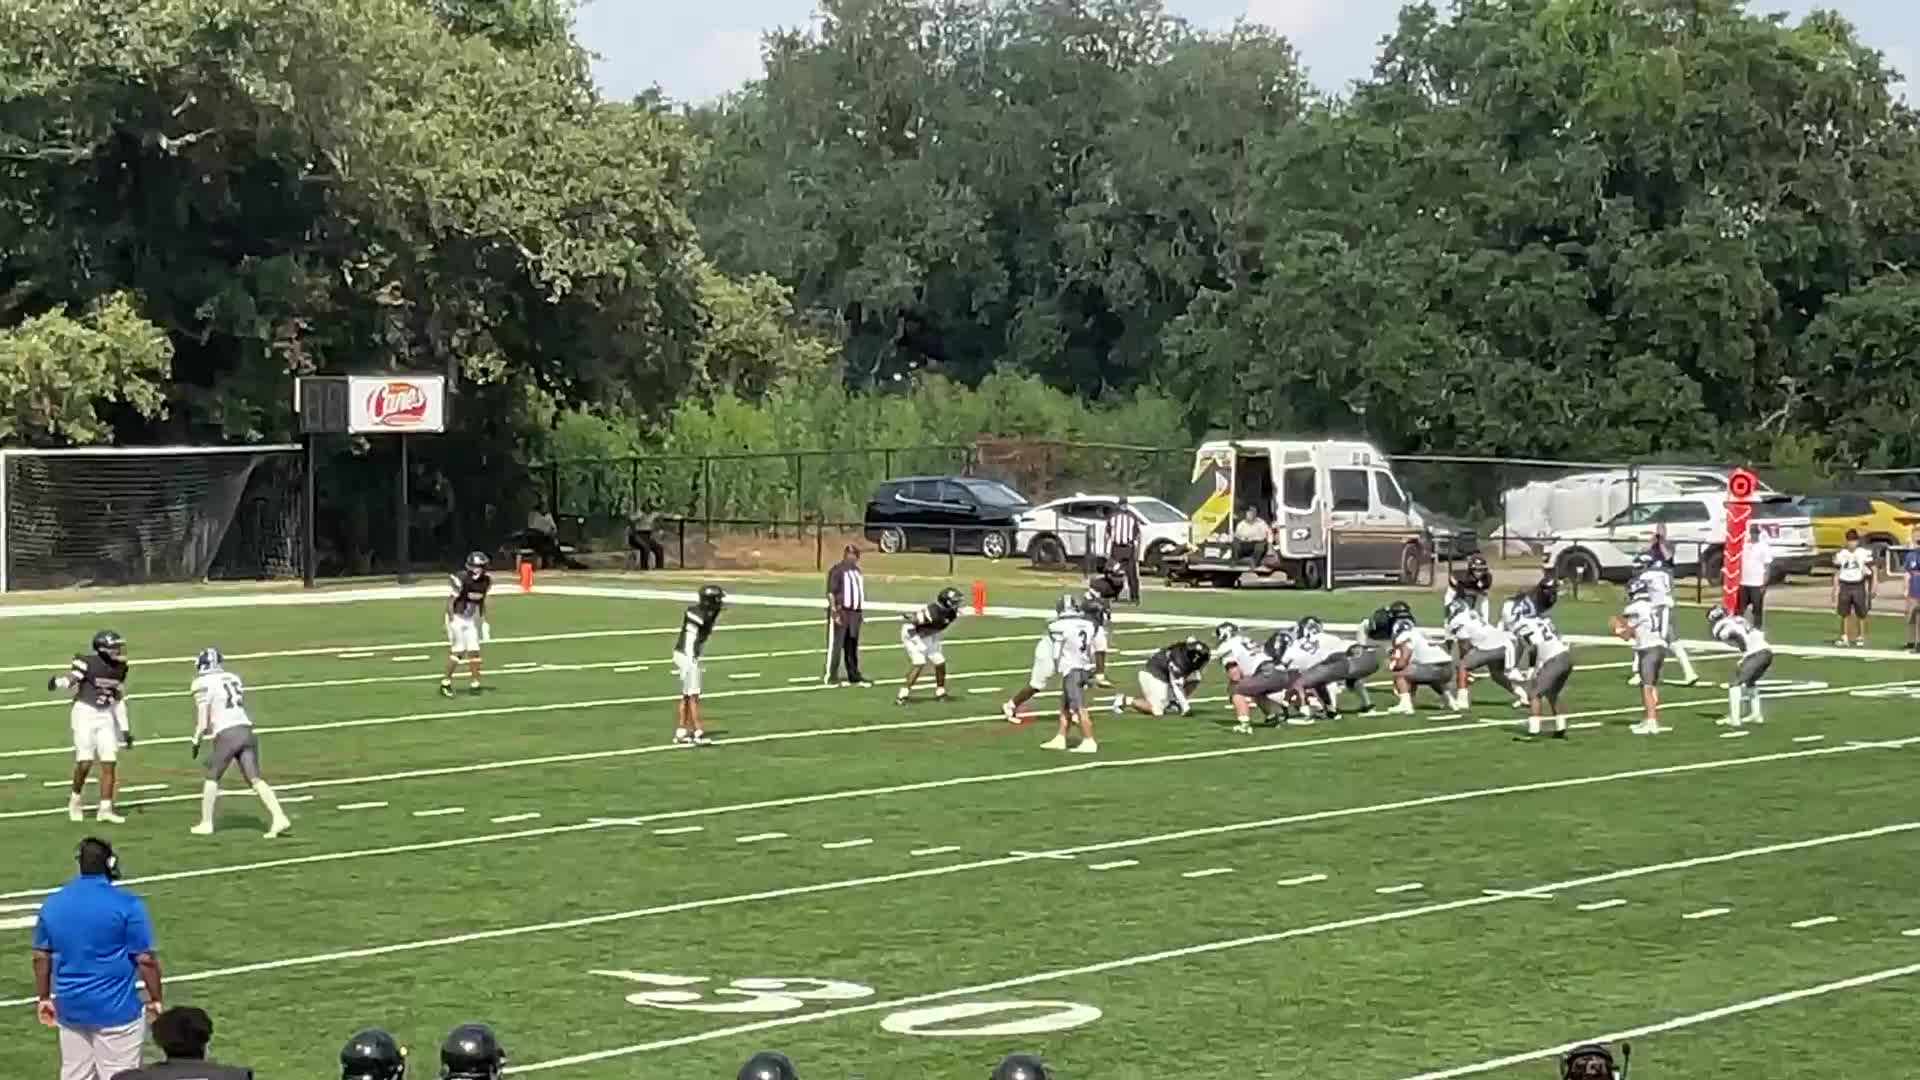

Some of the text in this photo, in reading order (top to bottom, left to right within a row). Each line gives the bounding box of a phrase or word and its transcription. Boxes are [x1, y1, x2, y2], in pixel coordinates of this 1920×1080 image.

[1078, 630, 1088, 652] 3
[223, 681, 243, 709] 15
[625, 977, 1099, 1036] 30
